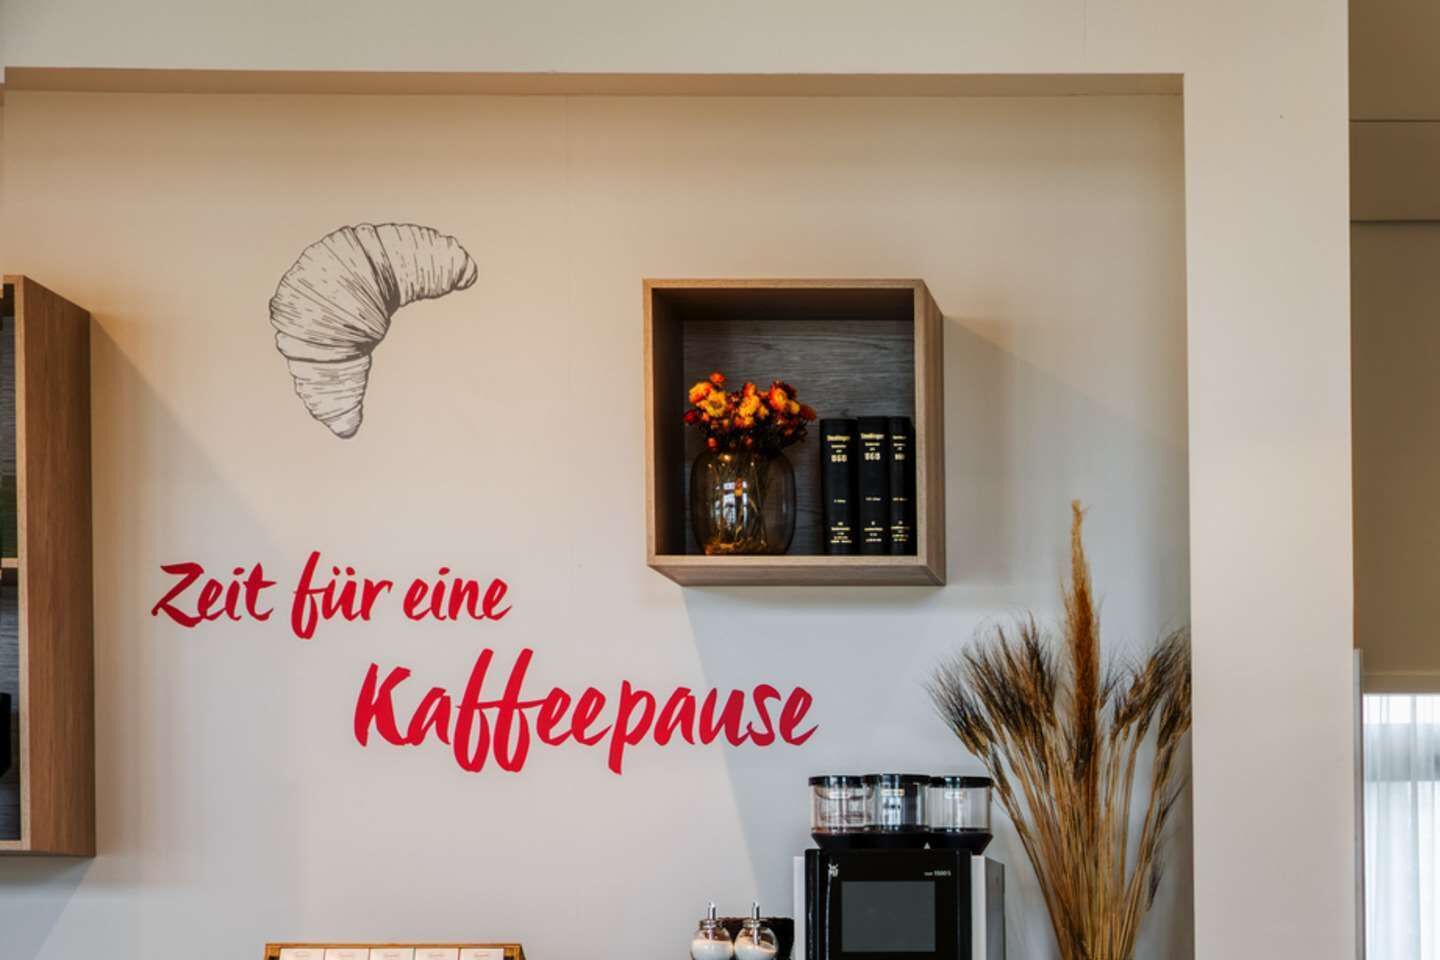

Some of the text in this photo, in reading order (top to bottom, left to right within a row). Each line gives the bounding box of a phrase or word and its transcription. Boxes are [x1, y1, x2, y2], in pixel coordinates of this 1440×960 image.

[151, 550, 512, 640] Zeit für eine
[353, 647, 819, 774] Kaffeepause
